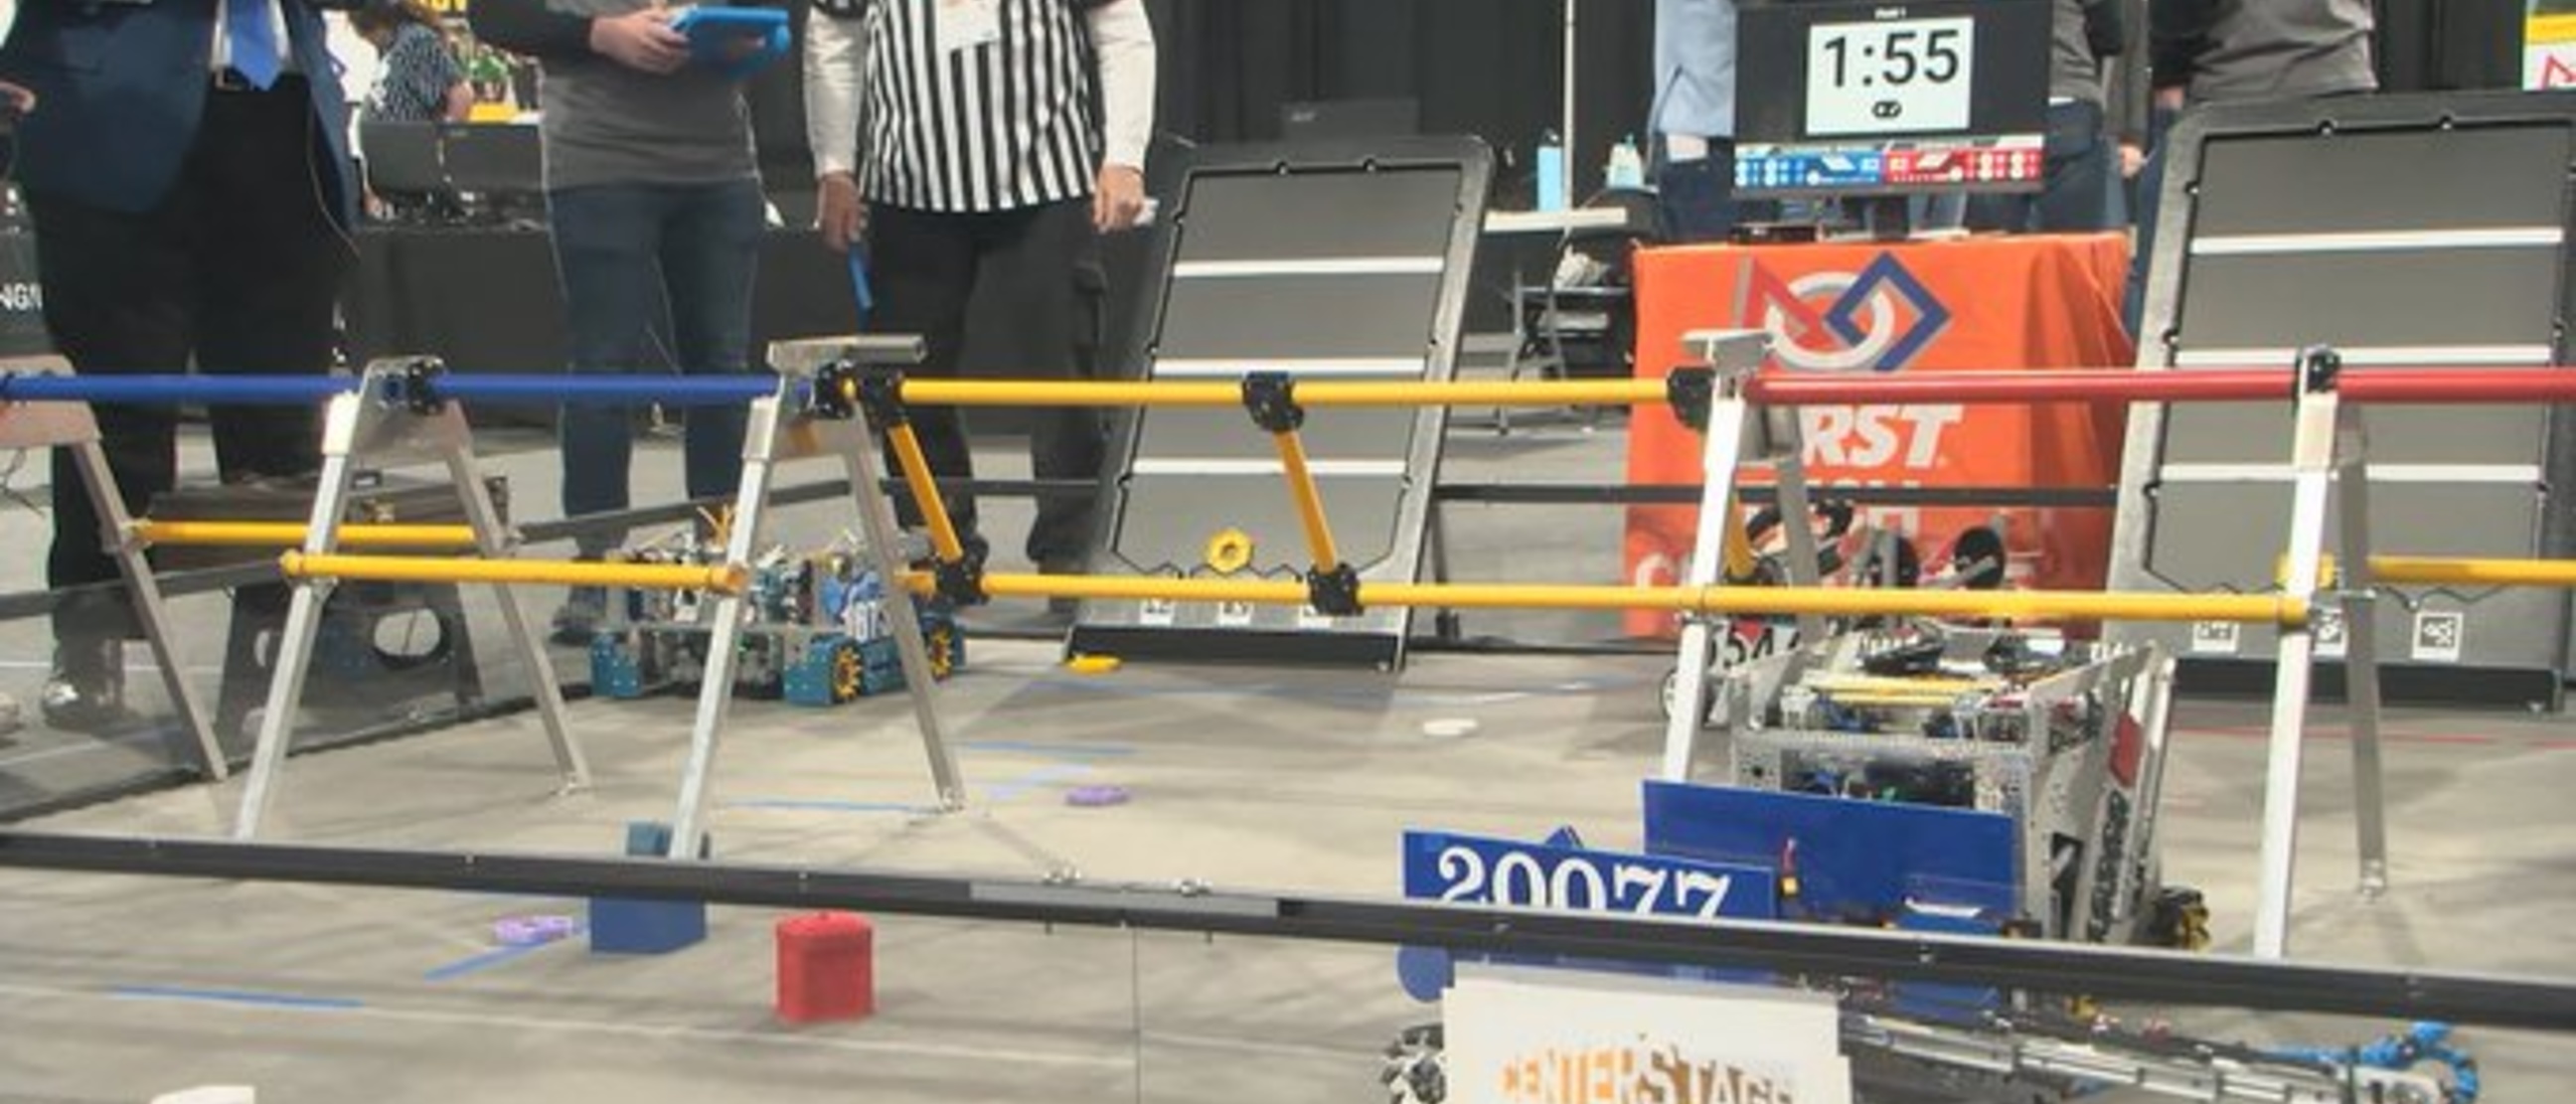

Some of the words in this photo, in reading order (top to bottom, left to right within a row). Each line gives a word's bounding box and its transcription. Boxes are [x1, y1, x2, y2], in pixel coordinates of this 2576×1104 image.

[1824, 29, 1960, 88] 1:55
[1798, 403, 1964, 468] RST
[1437, 846, 1731, 919] 20077
